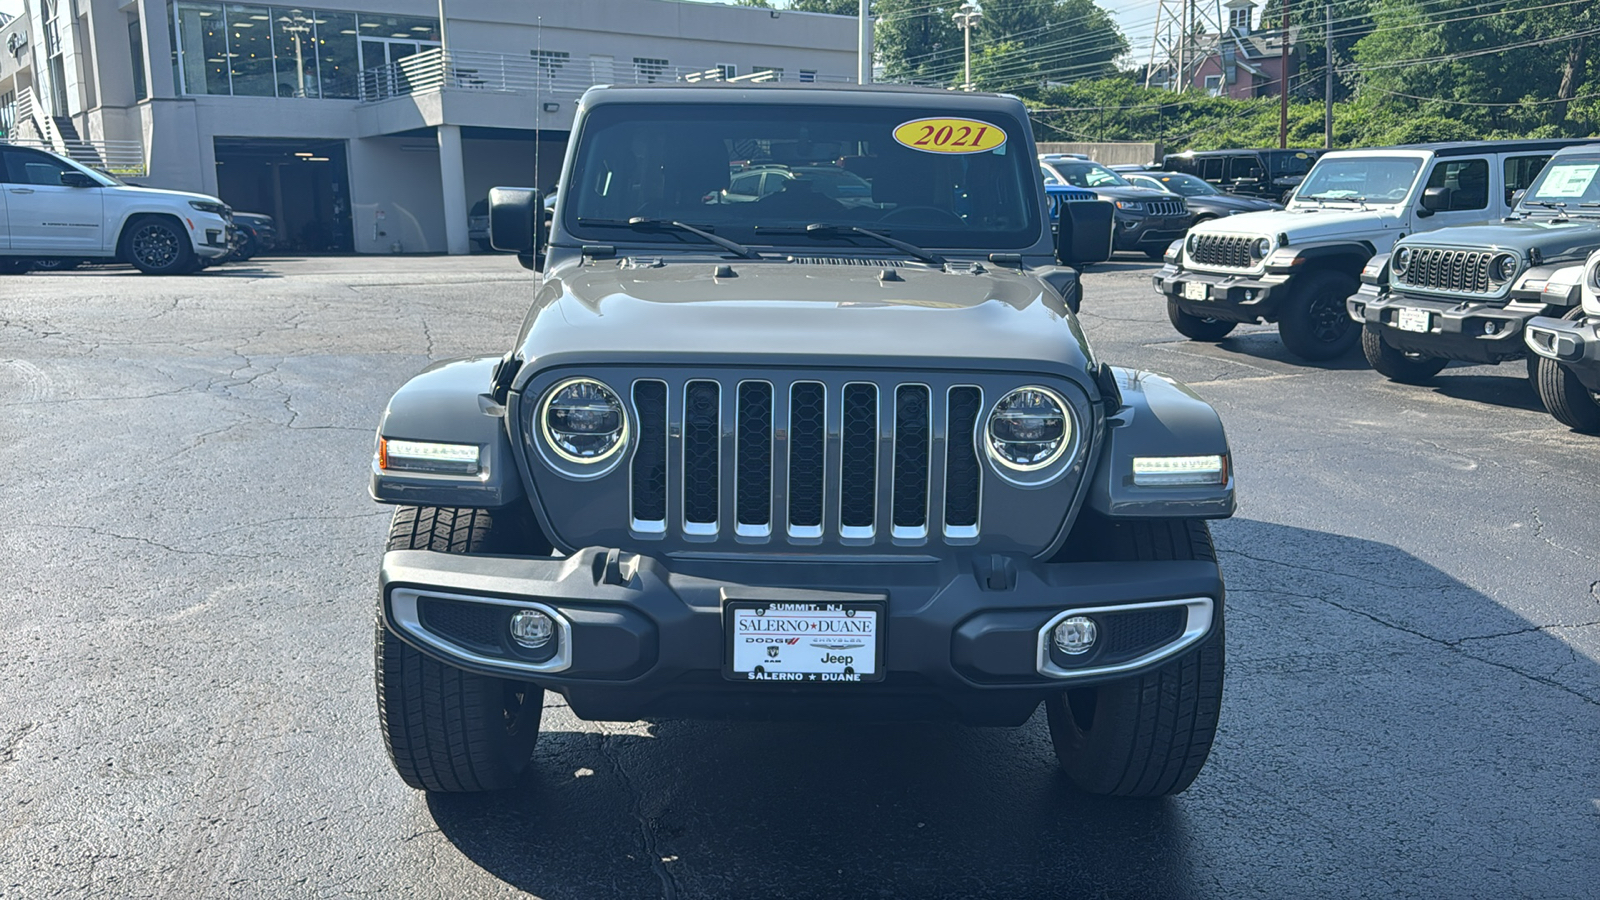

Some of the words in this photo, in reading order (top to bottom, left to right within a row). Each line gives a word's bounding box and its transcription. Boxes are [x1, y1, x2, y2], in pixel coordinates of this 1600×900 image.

[913, 125, 987, 147] 2021
[826, 603, 843, 612] NJ
[739, 619, 809, 632] SALERNO
[818, 620, 872, 633] DUANE
[820, 652, 854, 666] Jeep
[747, 671, 803, 681] SALERNO
[821, 673, 861, 682] DUANE
